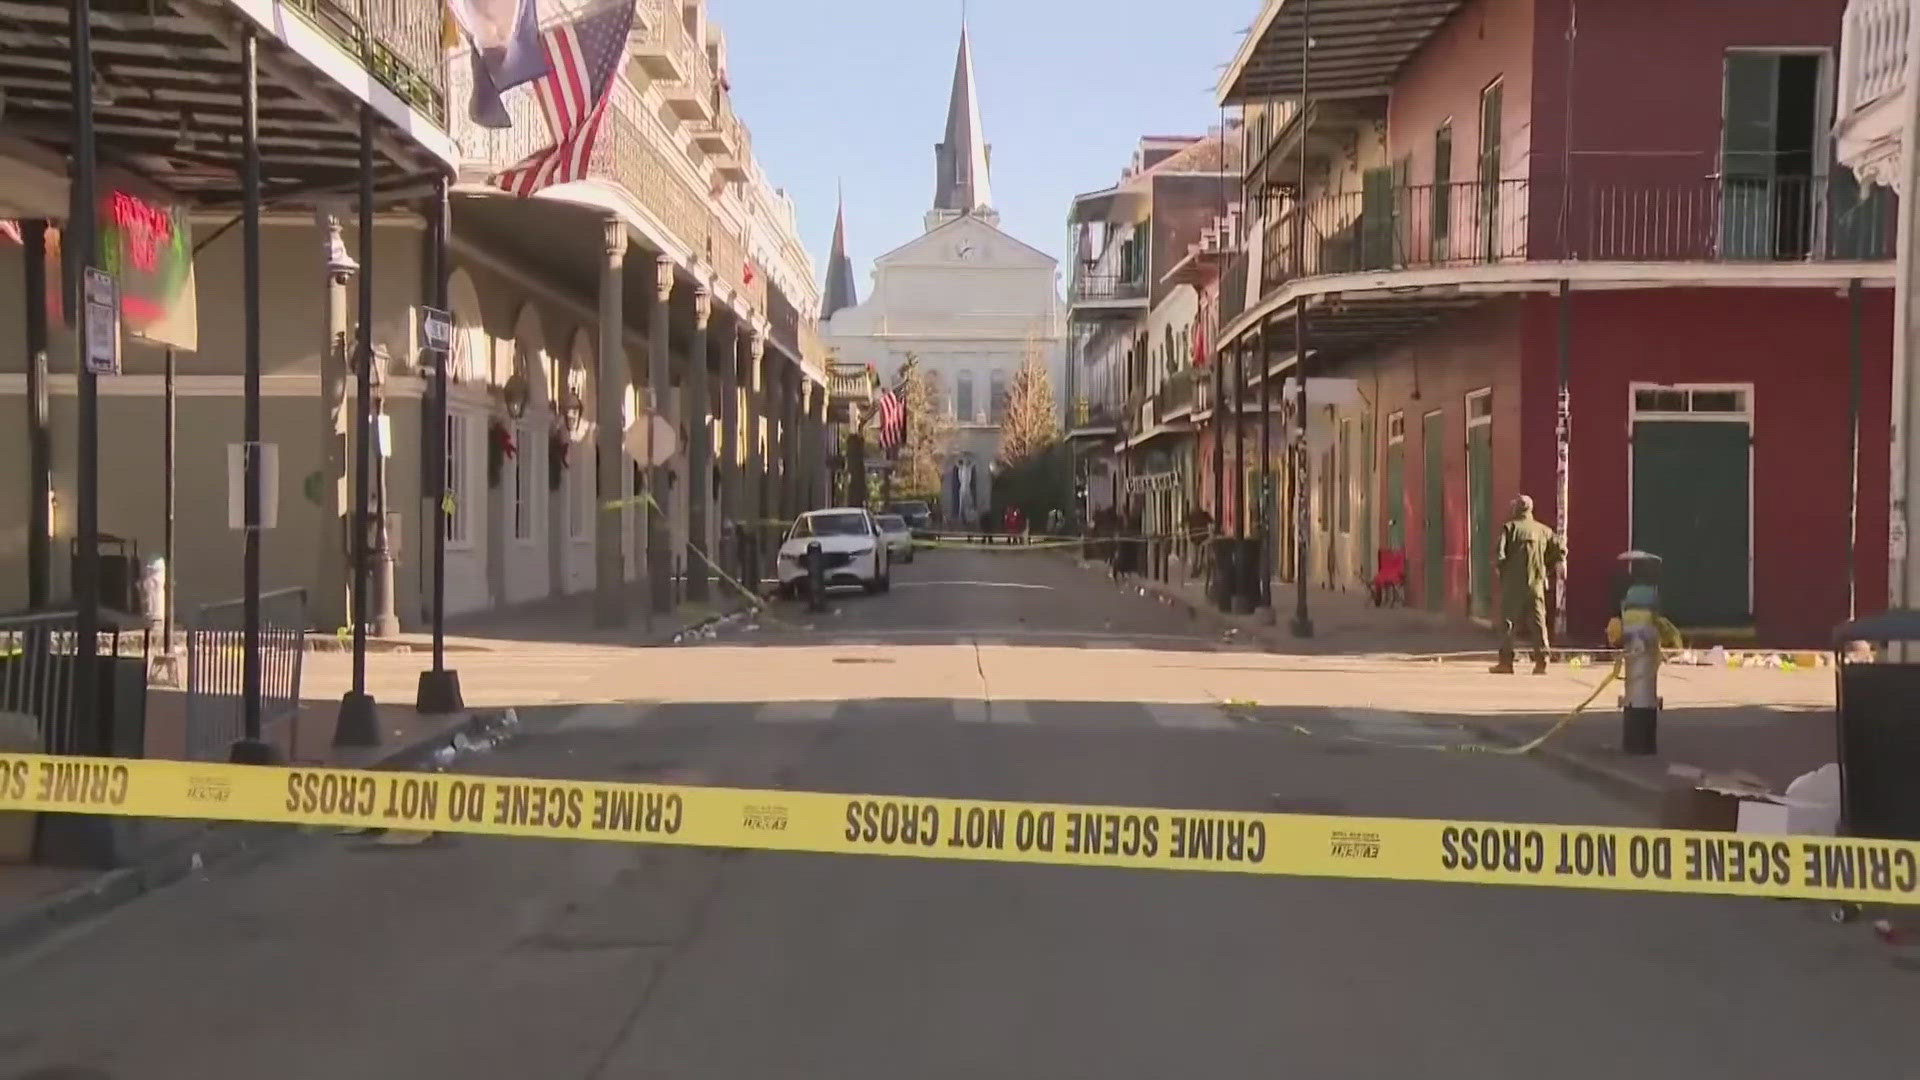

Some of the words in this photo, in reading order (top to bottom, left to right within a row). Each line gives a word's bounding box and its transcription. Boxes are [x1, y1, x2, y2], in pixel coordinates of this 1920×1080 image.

[36, 761, 129, 806] CRIME
[286, 773, 376, 816] CROSS
[383, 779, 439, 821] NOT
[448, 781, 486, 823] DO
[493, 785, 584, 828] SCENE
[591, 790, 683, 834] CRIME
[845, 801, 940, 847] CROSS
[947, 806, 1006, 850] NOT
[1015, 809, 1055, 853] DO
[1065, 813, 1160, 858] SCENE
[1169, 817, 1266, 863] CRIME
[1441, 826, 1545, 874] CROSS
[1554, 832, 1617, 877] NOT
[1629, 835, 1673, 881] DO
[1684, 838, 1791, 886] SCENE
[1804, 844, 1918, 893] CRIME
